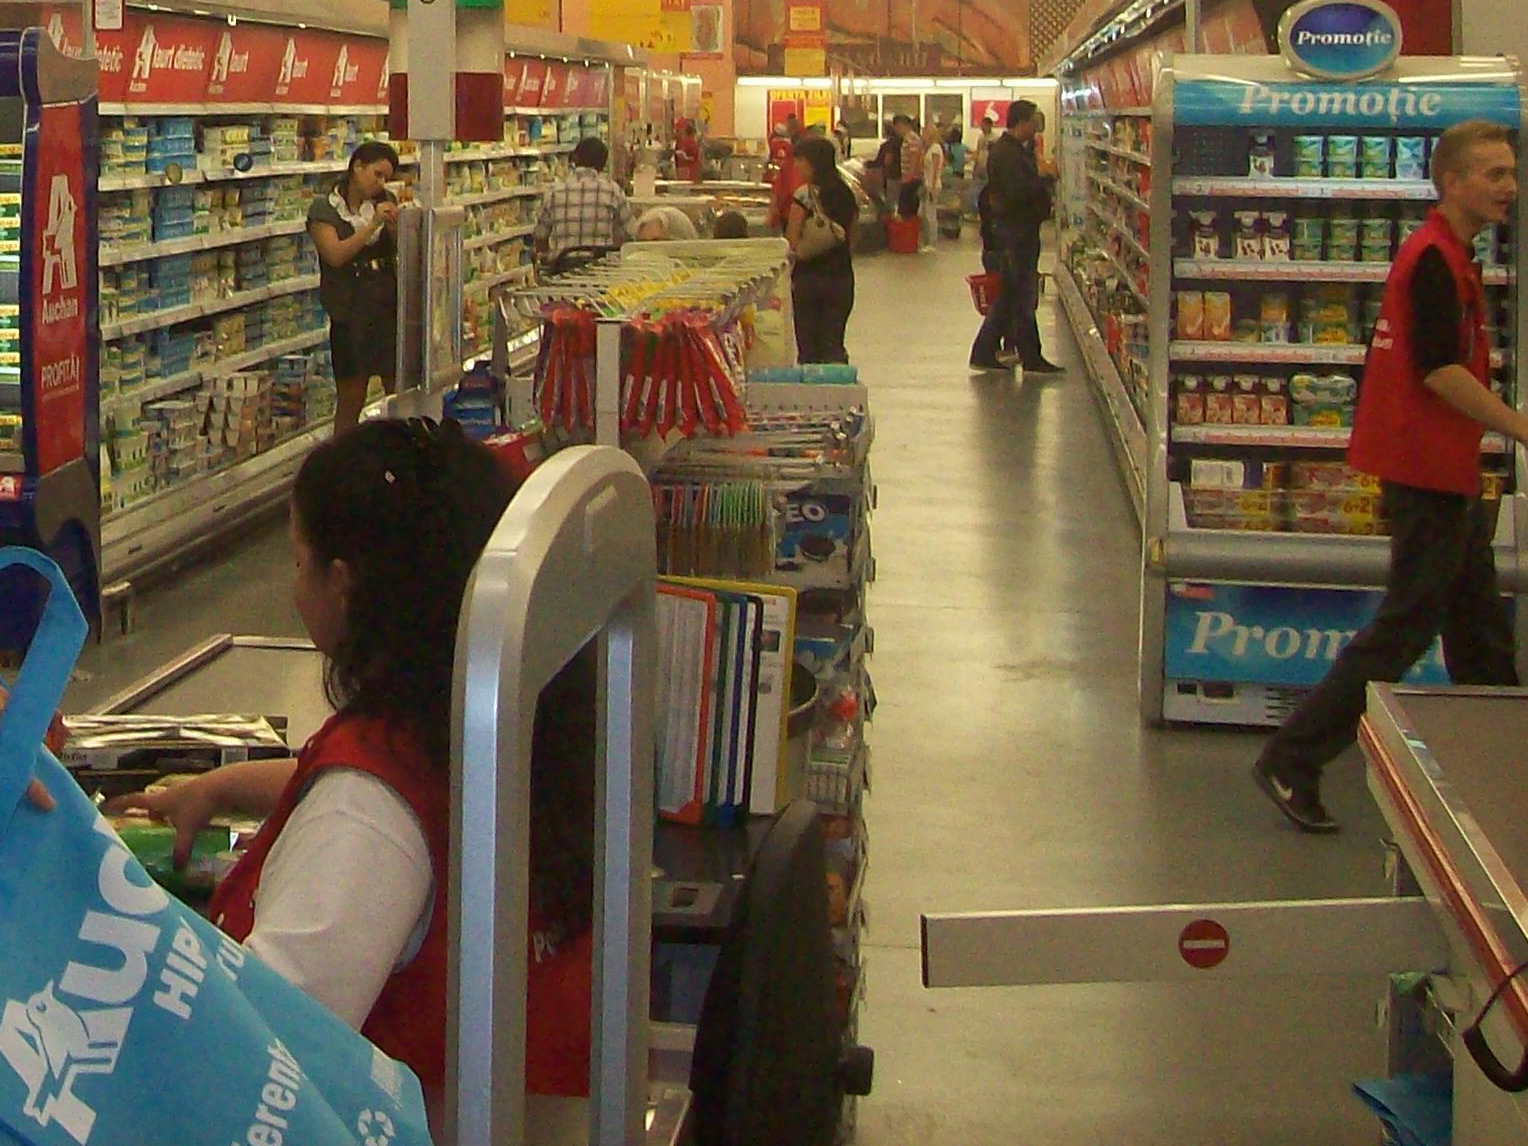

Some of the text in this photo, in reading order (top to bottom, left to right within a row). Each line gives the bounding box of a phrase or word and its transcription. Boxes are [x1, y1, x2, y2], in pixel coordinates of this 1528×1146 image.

[42, 294, 79, 325] Auchan
[786, 502, 826, 523] EO
[1185, 611, 1358, 660] Prom
